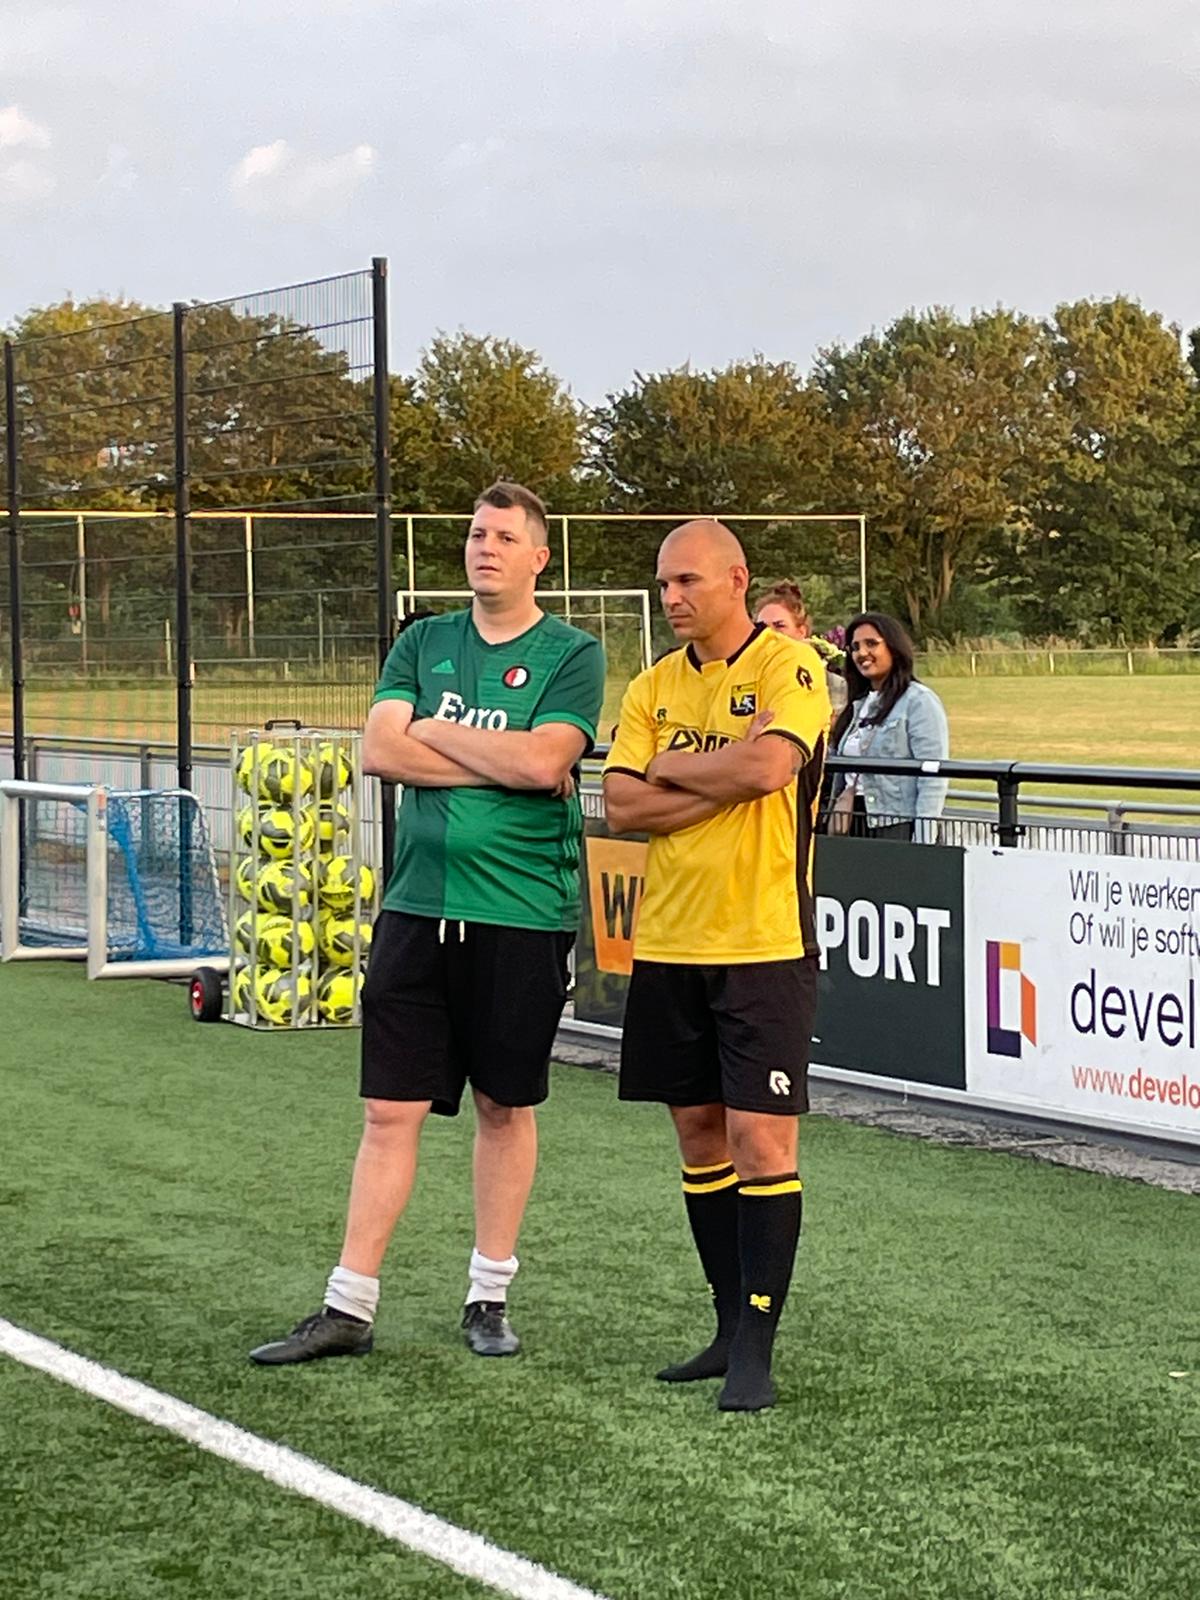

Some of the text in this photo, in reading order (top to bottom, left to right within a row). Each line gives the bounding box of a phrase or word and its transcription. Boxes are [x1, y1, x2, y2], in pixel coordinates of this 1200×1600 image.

[601, 872, 645, 941] W
[1070, 870, 1099, 903] Wil
[1104, 871, 1122, 912] je
[1070, 912, 1093, 945] Of
[1099, 916, 1125, 949] wil
[1130, 918, 1149, 959] je
[1071, 1064, 1200, 1110] www.develo
